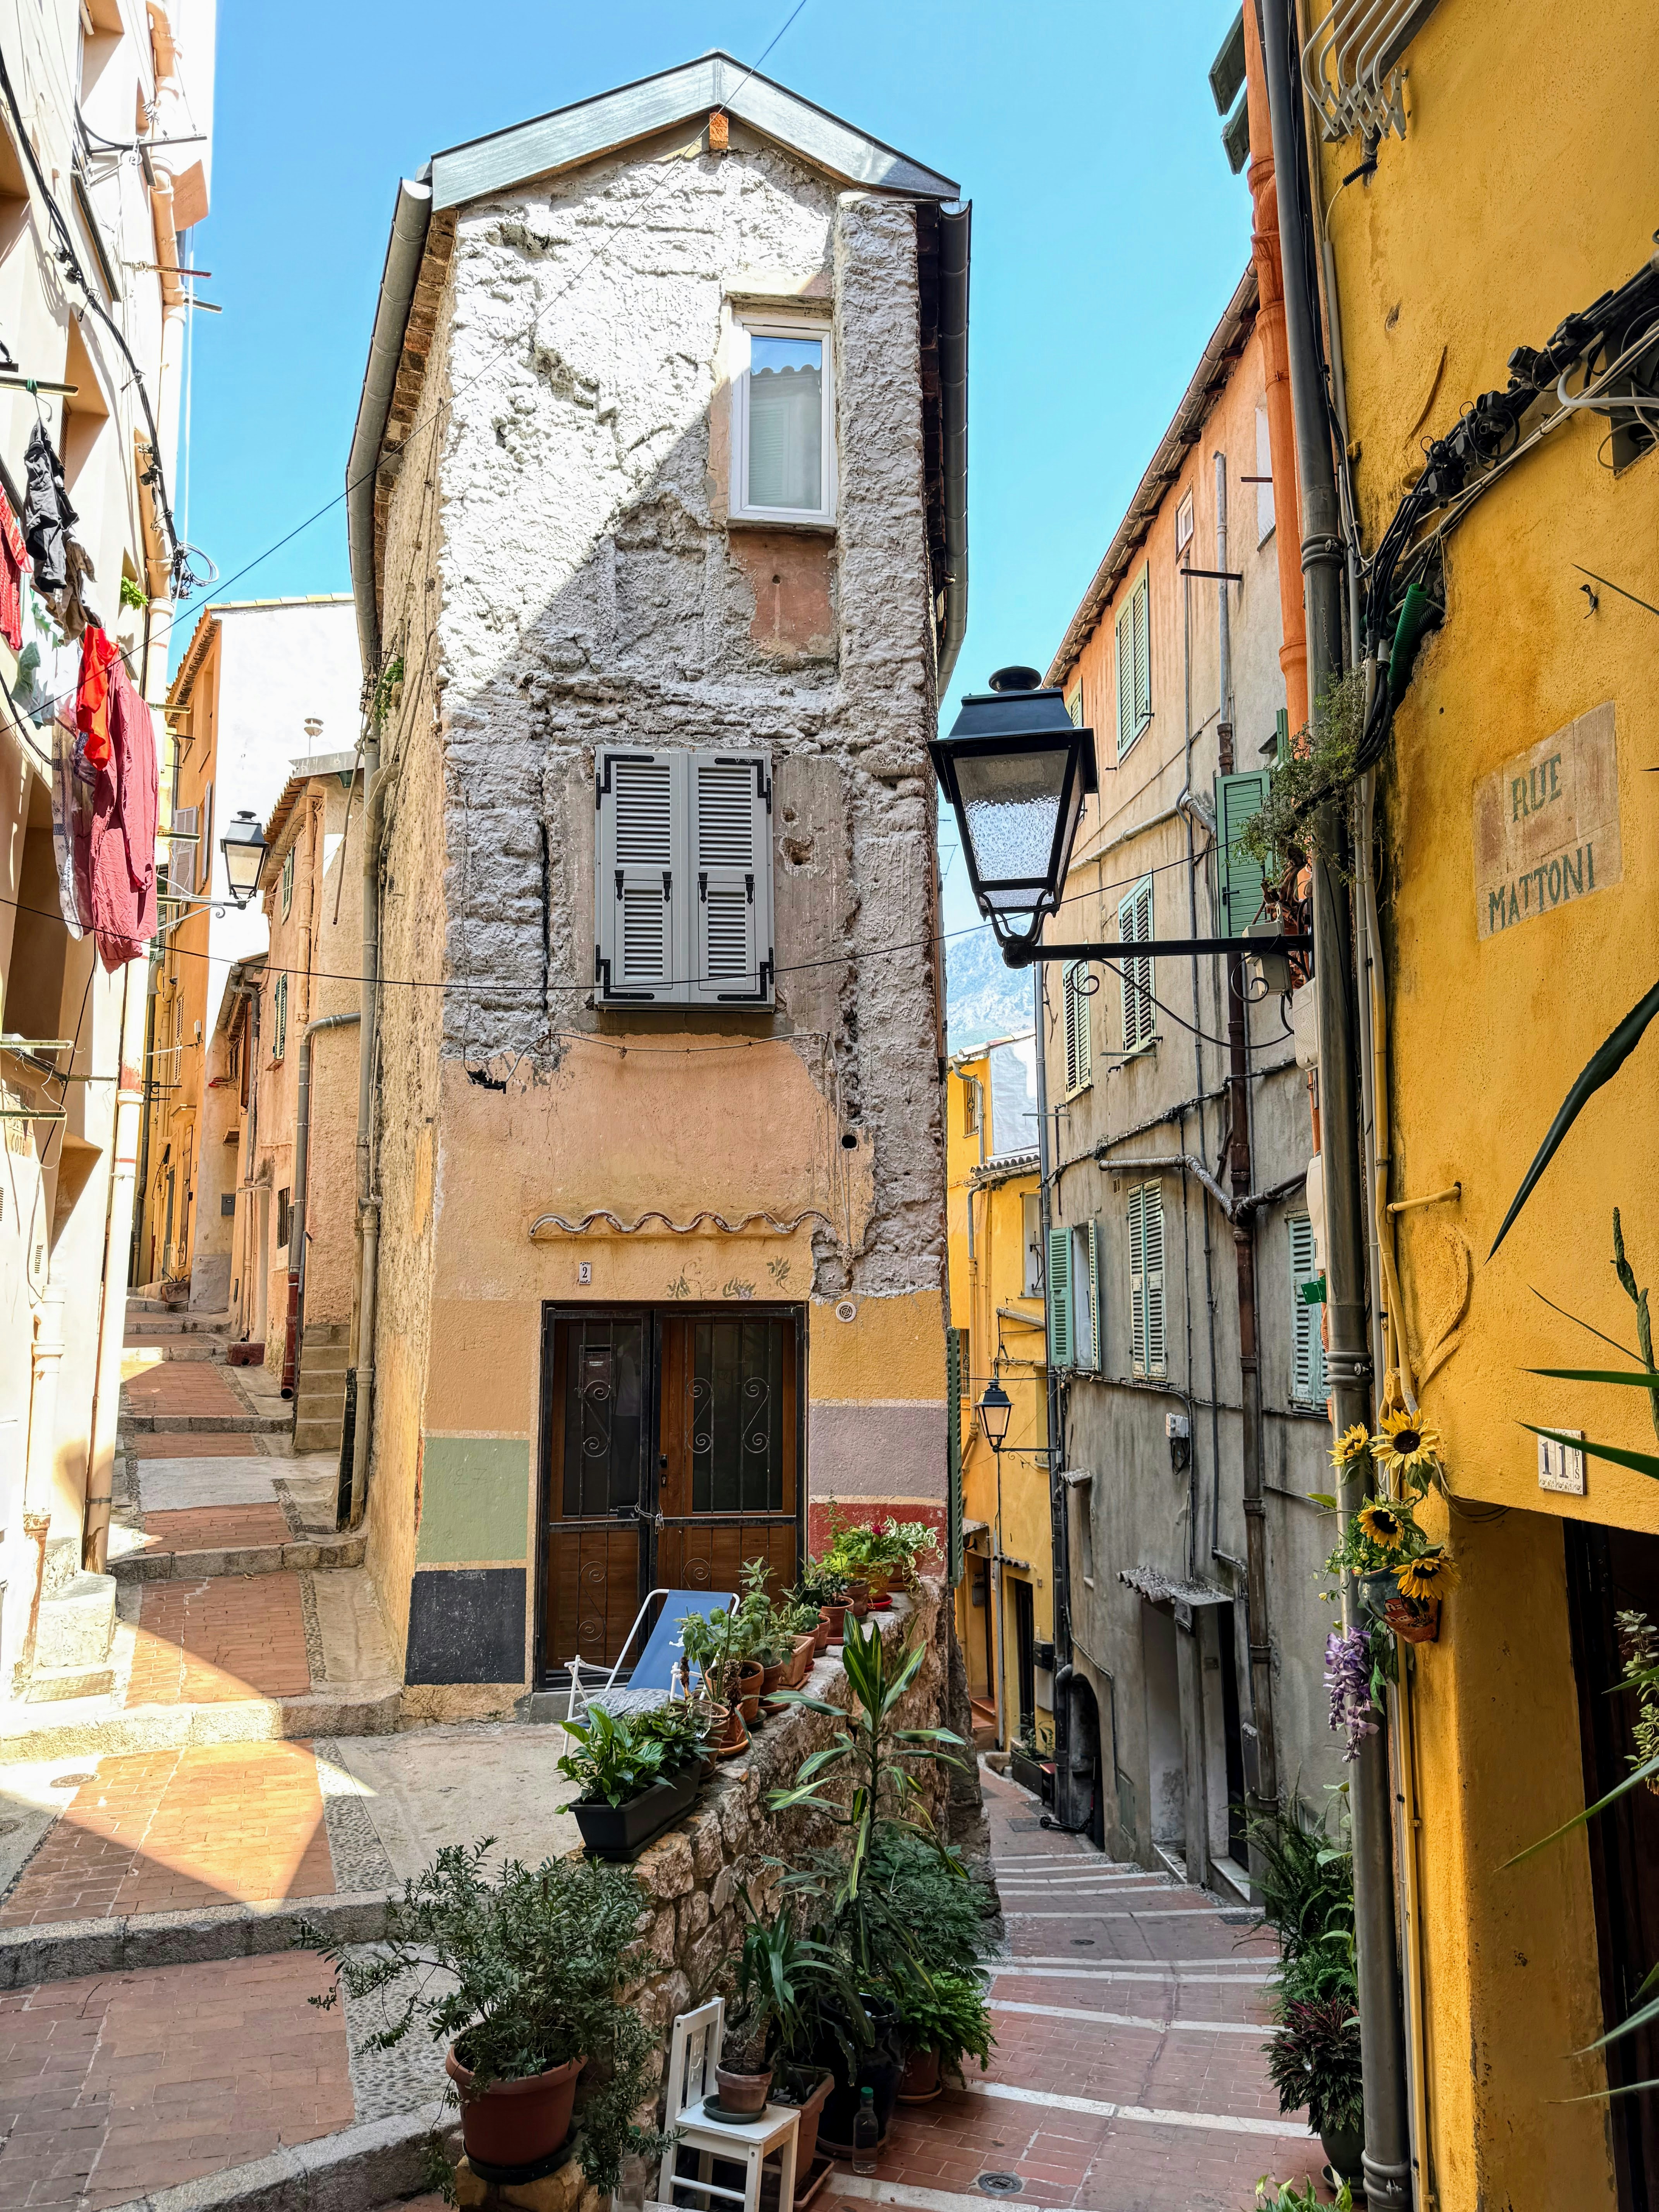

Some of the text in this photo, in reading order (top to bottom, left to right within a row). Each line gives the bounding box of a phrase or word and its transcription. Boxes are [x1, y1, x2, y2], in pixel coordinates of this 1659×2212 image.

[1511, 754, 1562, 823] RUE
[1488, 842, 1595, 933] MATTONI
[582, 1267, 587, 1278] 2
[1542, 1441, 1569, 1478] 11
